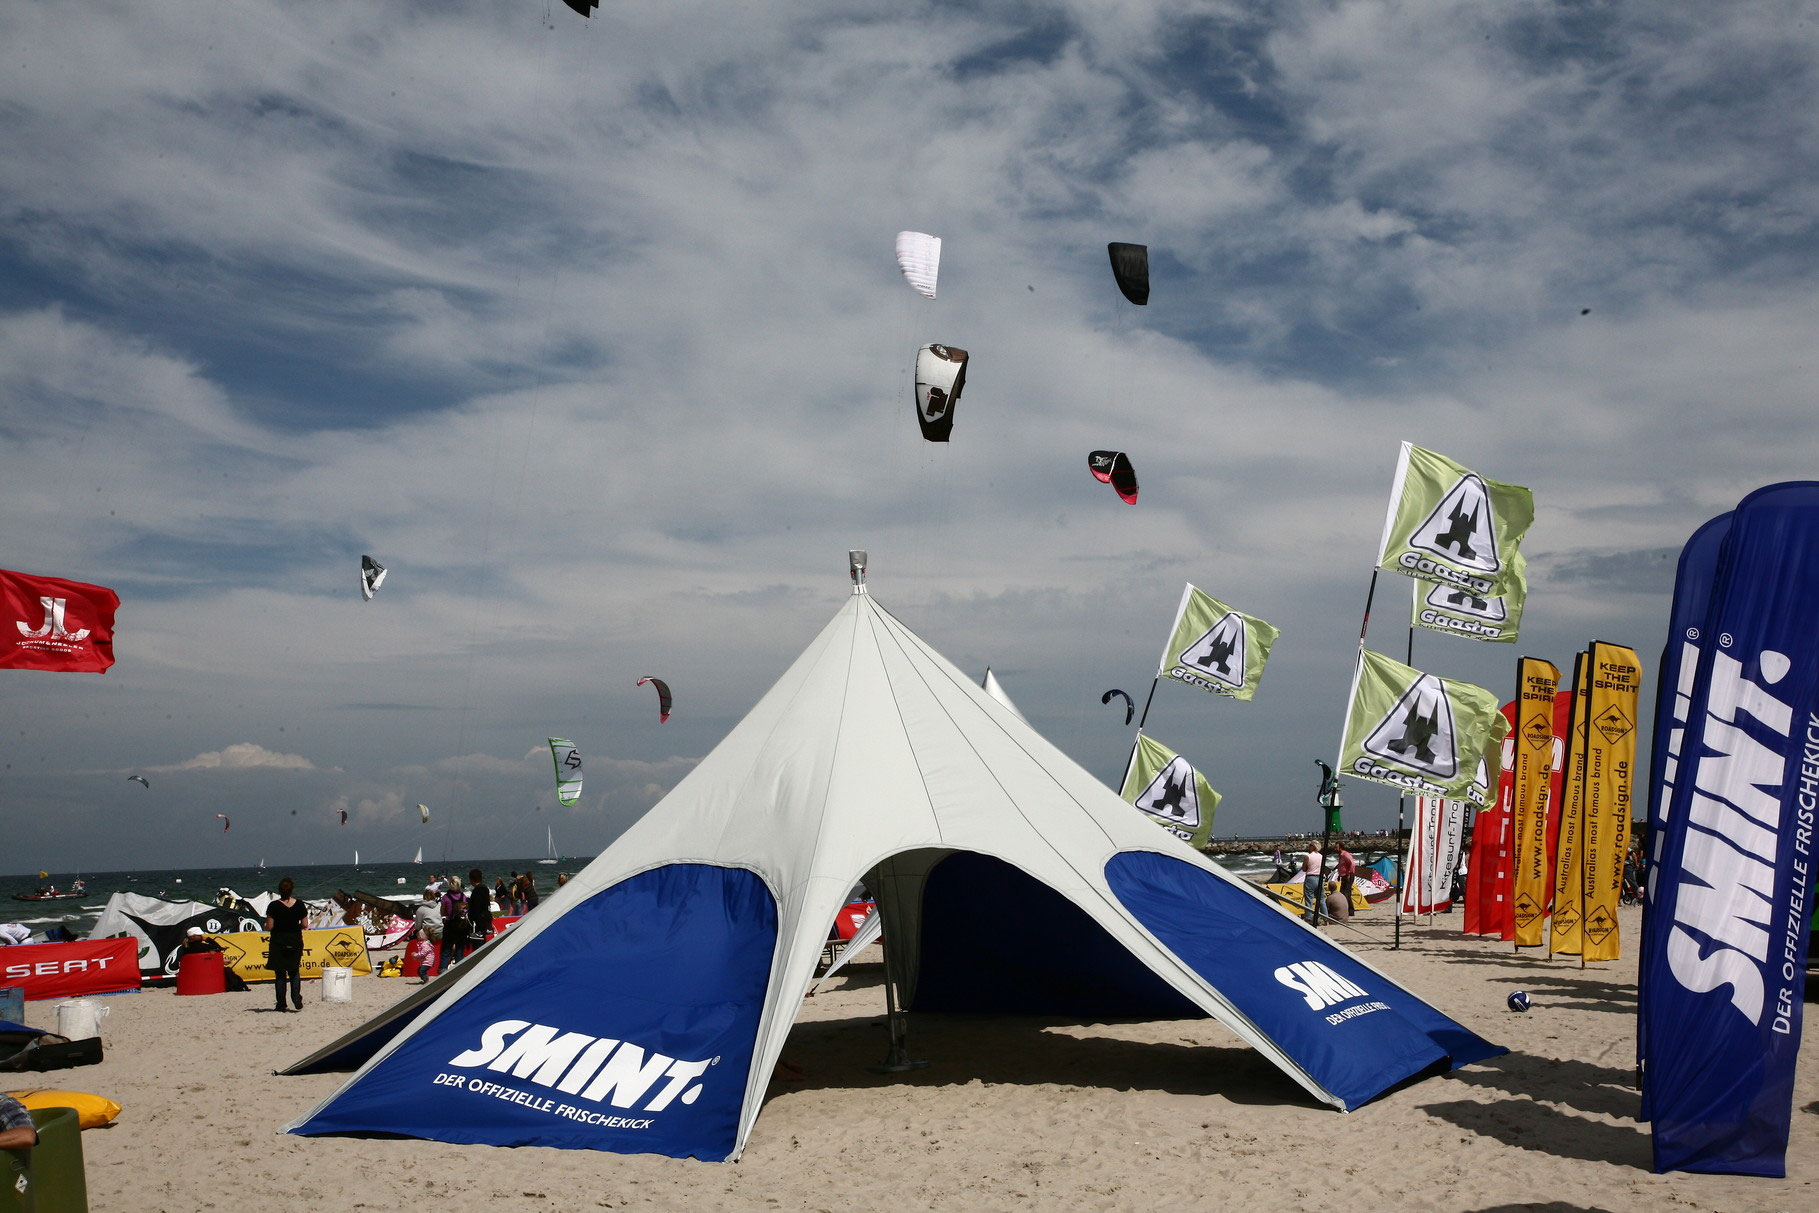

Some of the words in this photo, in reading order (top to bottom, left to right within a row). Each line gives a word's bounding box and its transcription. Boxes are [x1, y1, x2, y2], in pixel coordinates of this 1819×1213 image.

[1399, 551, 1494, 594] Gaastra
[1420, 608, 1502, 638] Gaastra
[1600, 662, 1636, 674] KEEP
[1604, 672, 1630, 683] THE
[1595, 680, 1638, 693] SPIRIT
[1519, 753, 1529, 781] brand
[1572, 753, 1584, 782] brand
[1591, 748, 1602, 778] brand
[1517, 784, 1526, 816] famous
[1589, 782, 1601, 818] famous
[1795, 711, 1819, 856] FRISCHEKICK
[1568, 785, 1580, 820] famous
[1516, 819, 1524, 841] most
[1533, 764, 1550, 880] www.roadsign.de
[1566, 821, 1575, 844] most
[1590, 821, 1598, 844] most
[1611, 761, 1629, 890] www.roadsign.de
[1440, 799, 1459, 890] Kitesurf-Tro
[1557, 847, 1571, 895] Australias
[1584, 848, 1597, 899] Australias
[1782, 859, 1807, 982] OFFIZIELLE
[6, 956, 114, 978] SEAT
[1772, 988, 1793, 1034] DER
[433, 1073, 464, 1088] DER
[468, 1078, 555, 1112] OFFIZIELLE
[556, 1104, 654, 1129] FRISCHEKICK
